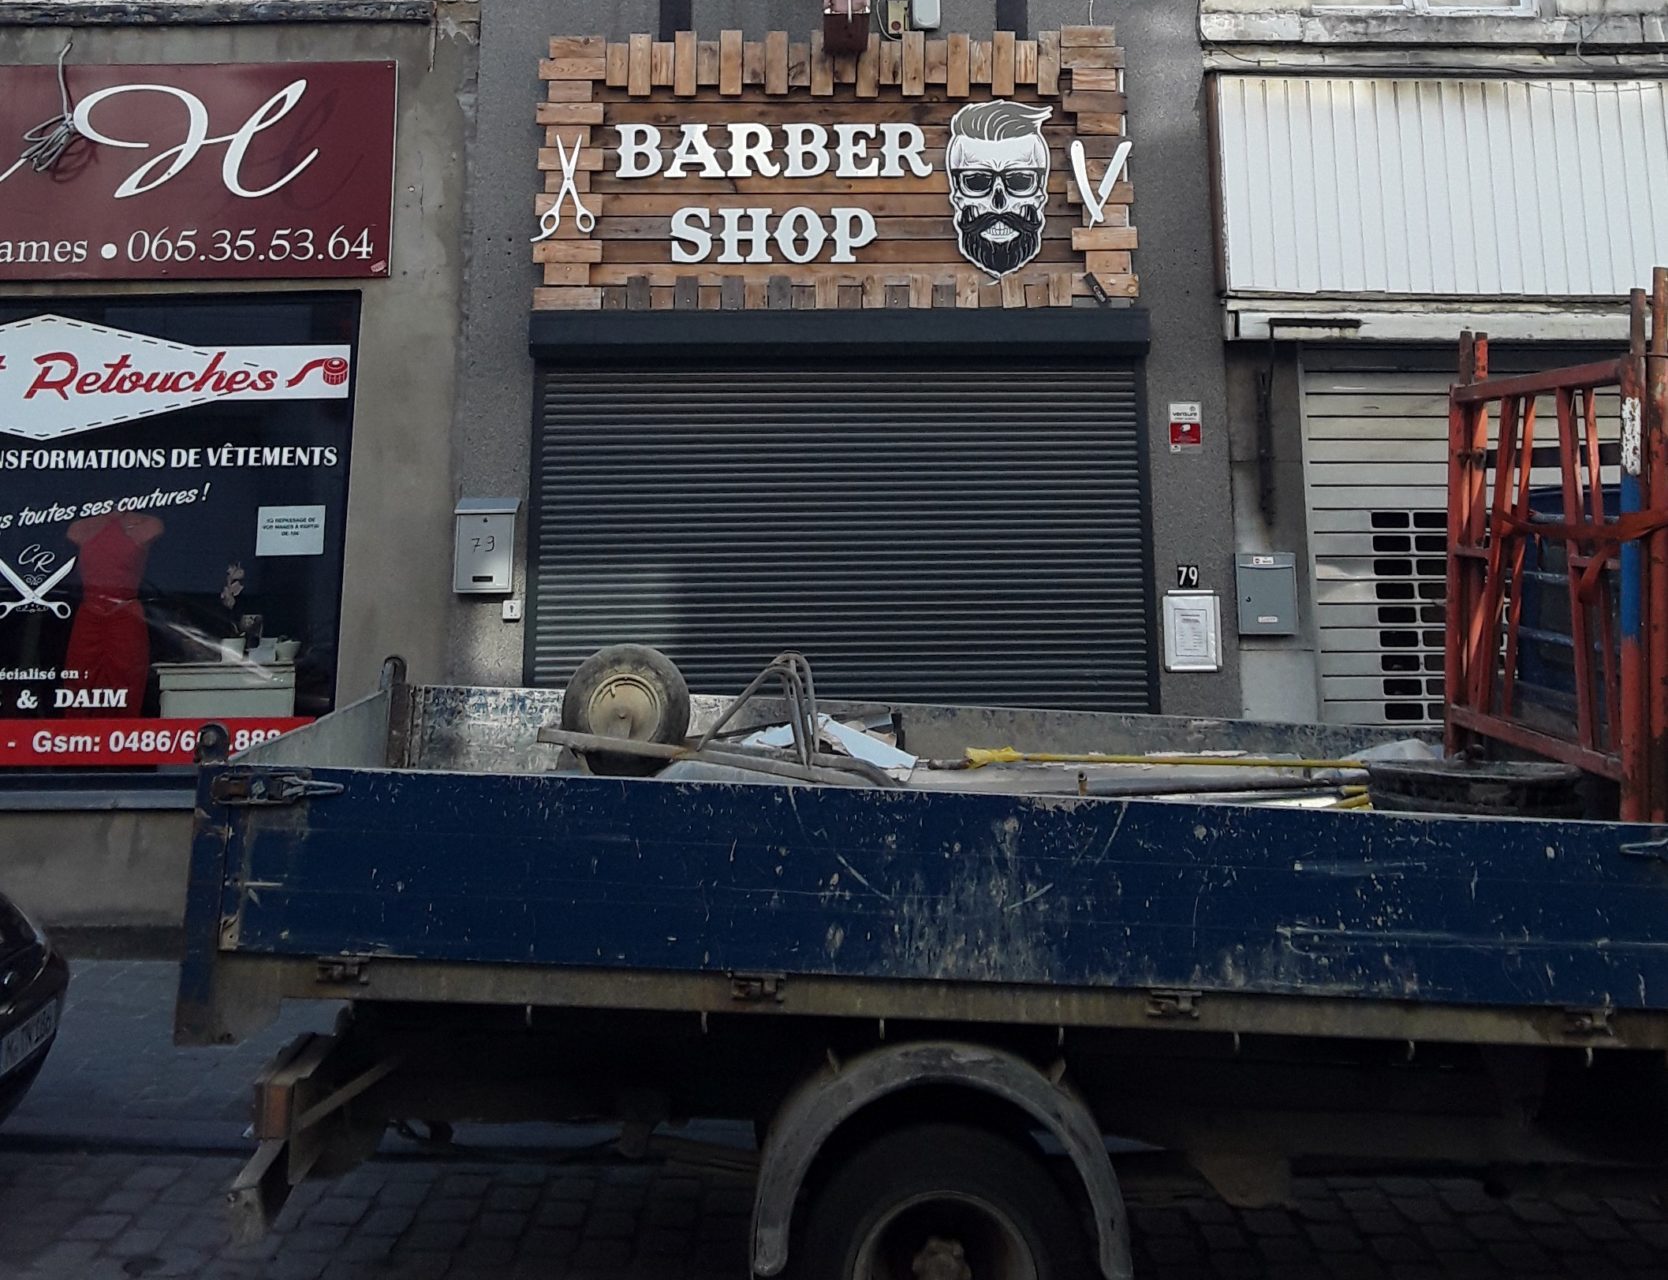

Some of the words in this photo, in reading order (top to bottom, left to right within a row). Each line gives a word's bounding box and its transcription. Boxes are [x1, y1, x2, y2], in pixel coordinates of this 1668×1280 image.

[614, 122, 933, 179] BARBER
[127, 225, 375, 263] 065.35.53.64
[668, 206, 878, 264] SHOP
[23, 351, 279, 401] Retouches
[170, 448, 202, 468] DE
[206, 442, 338, 467] VÊTEMENTS
[17, 502, 77, 528] toutes
[79, 499, 114, 518] ses
[117, 487, 200, 513] coutures
[471, 535, 496, 553] 73
[1178, 566, 1198, 586] 79
[0, 667, 56, 680] écialisé
[60, 669, 79, 680] en
[16, 689, 39, 709] &
[53, 688, 129, 708] DAIM
[32, 730, 101, 753] Gsm:
[109, 729, 283, 754] 0486/6.88
